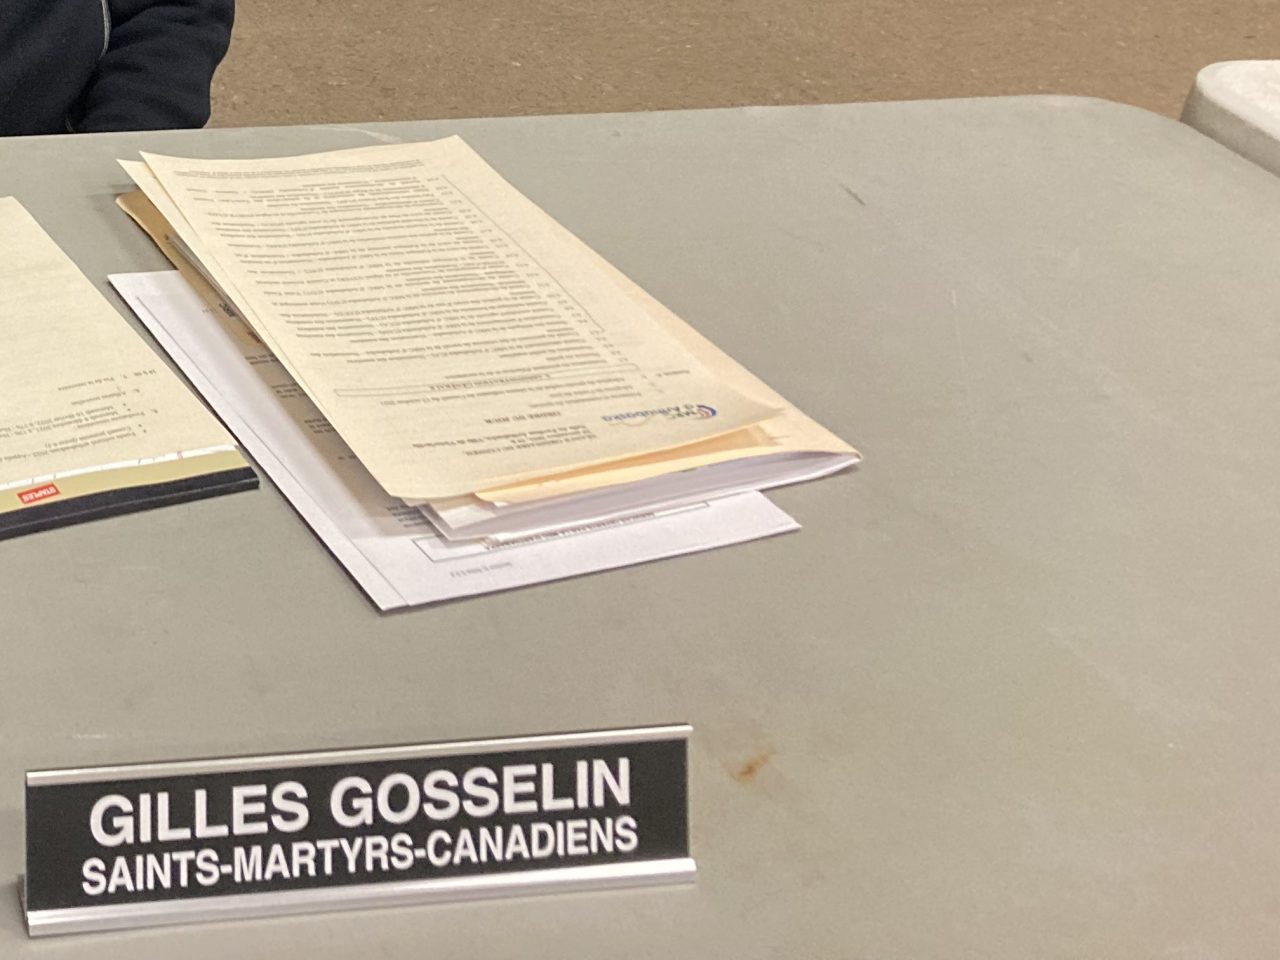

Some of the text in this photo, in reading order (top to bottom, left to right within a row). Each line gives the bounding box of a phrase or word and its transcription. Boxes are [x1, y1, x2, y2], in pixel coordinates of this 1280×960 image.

[21, 486, 58, 503] STAPLES
[90, 757, 631, 846] GILLES GOSSELIN
[81, 815, 639, 896] SAINTS-MARTYRS-CANADIENS
